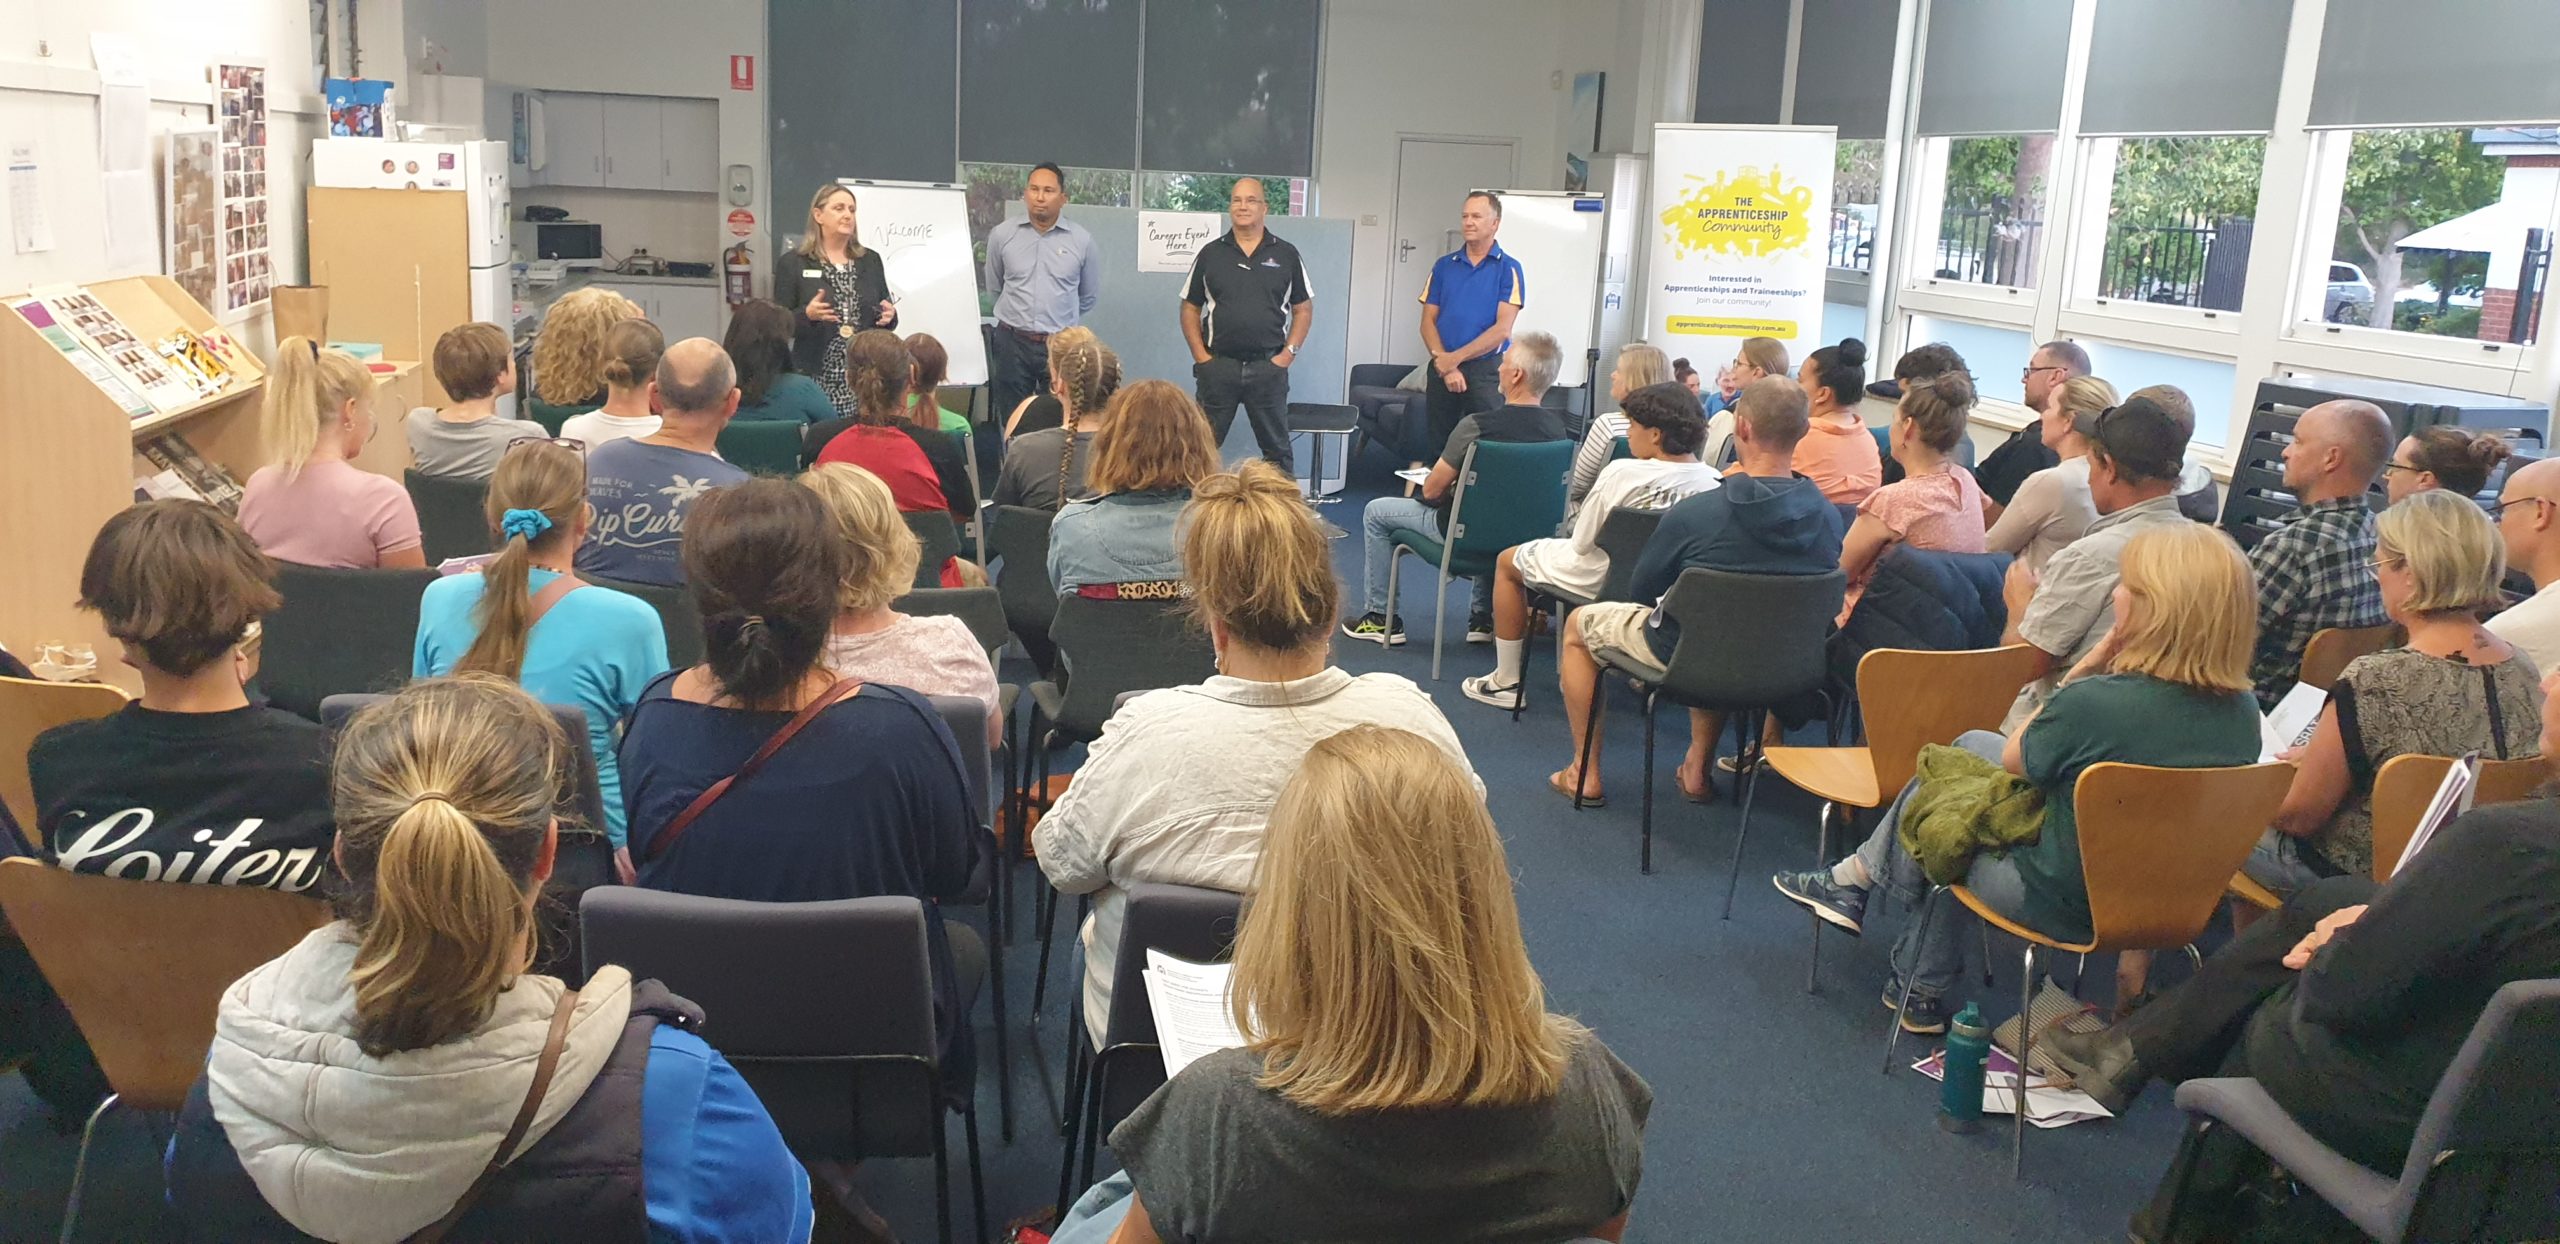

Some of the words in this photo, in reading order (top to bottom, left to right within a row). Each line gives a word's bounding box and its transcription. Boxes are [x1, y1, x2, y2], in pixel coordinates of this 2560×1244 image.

[1735, 197, 1753, 207] THE
[1698, 208, 1788, 221] APPRENTICESHIP
[1149, 229, 1182, 243] Careers
[1185, 228, 1210, 243] Event
[1702, 219, 1782, 240] Community
[1709, 275, 1752, 283] Interested
[1754, 275, 1762, 283] in
[1664, 284, 1730, 294] Apprenticeships
[1749, 287, 1807, 297] Traineeships?
[1696, 296, 1711, 305] Join
[1676, 321, 1786, 332] apprenticeshipcommunity.com.au
[623, 503, 684, 538] Cur
